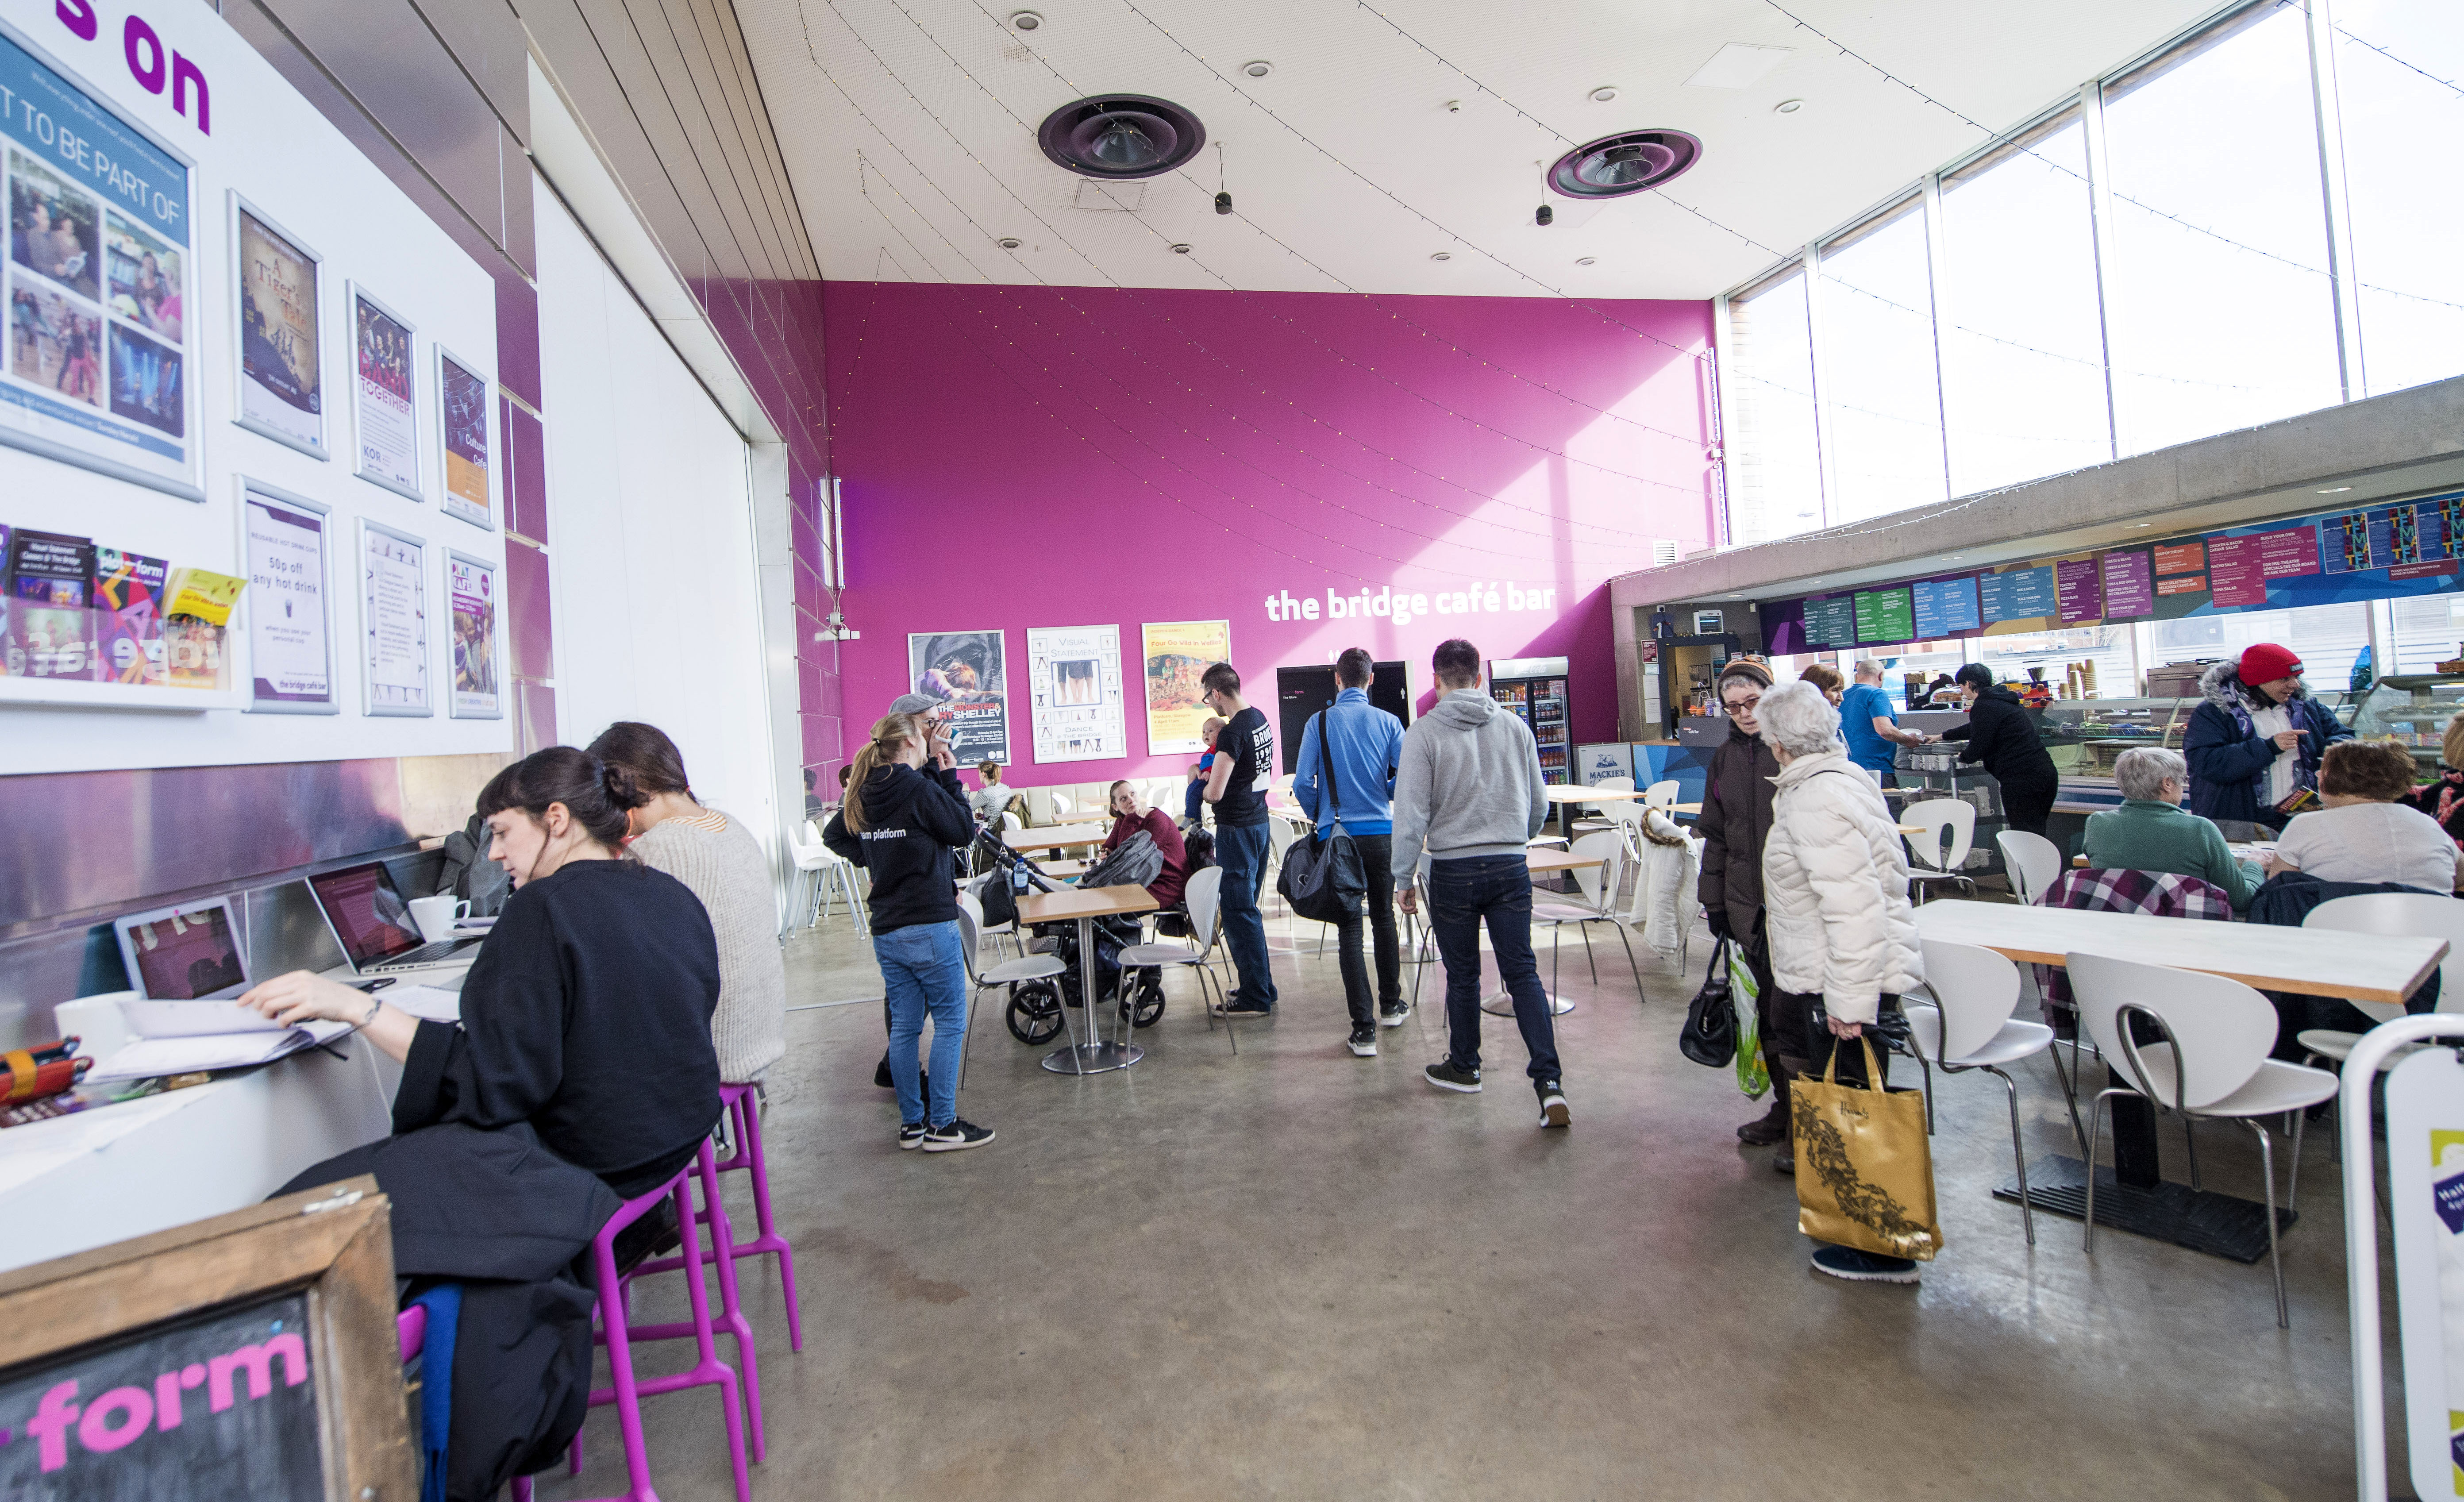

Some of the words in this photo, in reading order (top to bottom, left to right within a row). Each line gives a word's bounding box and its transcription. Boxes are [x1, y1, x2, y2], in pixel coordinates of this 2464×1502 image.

[124, 15, 210, 137] on
[21, 99, 54, 145] TO
[60, 127, 90, 171] BE
[95, 151, 150, 207] PART
[153, 192, 180, 225] OF
[273, 258, 282, 280] A
[255, 259, 300, 307] Tiger's
[359, 349, 409, 402] BAND
[361, 377, 410, 416] TOGETHER
[465, 433, 487, 454] Culture
[364, 445, 381, 463] KOR
[270, 557, 287, 574] 50p
[290, 563, 303, 575] off
[453, 563, 469, 578] PLAY
[253, 574, 271, 589] any
[276, 575, 291, 589] hot
[295, 580, 318, 595] drink
[1264, 590, 1320, 621] the
[1328, 586, 1428, 625] bridge
[1435, 582, 1501, 615] café
[1507, 581, 1555, 611] bar
[1059, 638, 1090, 646] VISUAL
[1051, 649, 1098, 658] STATEMENT
[279, 679, 289, 688] the
[289, 679, 306, 692] bridge
[318, 681, 327, 689] bar
[939, 711, 953, 720] RY
[953, 708, 1001, 719] SHELLEY
[954, 703, 995, 711] MONSTER
[1590, 769, 1625, 779] MACKIE'S
[873, 828, 906, 841] platform
